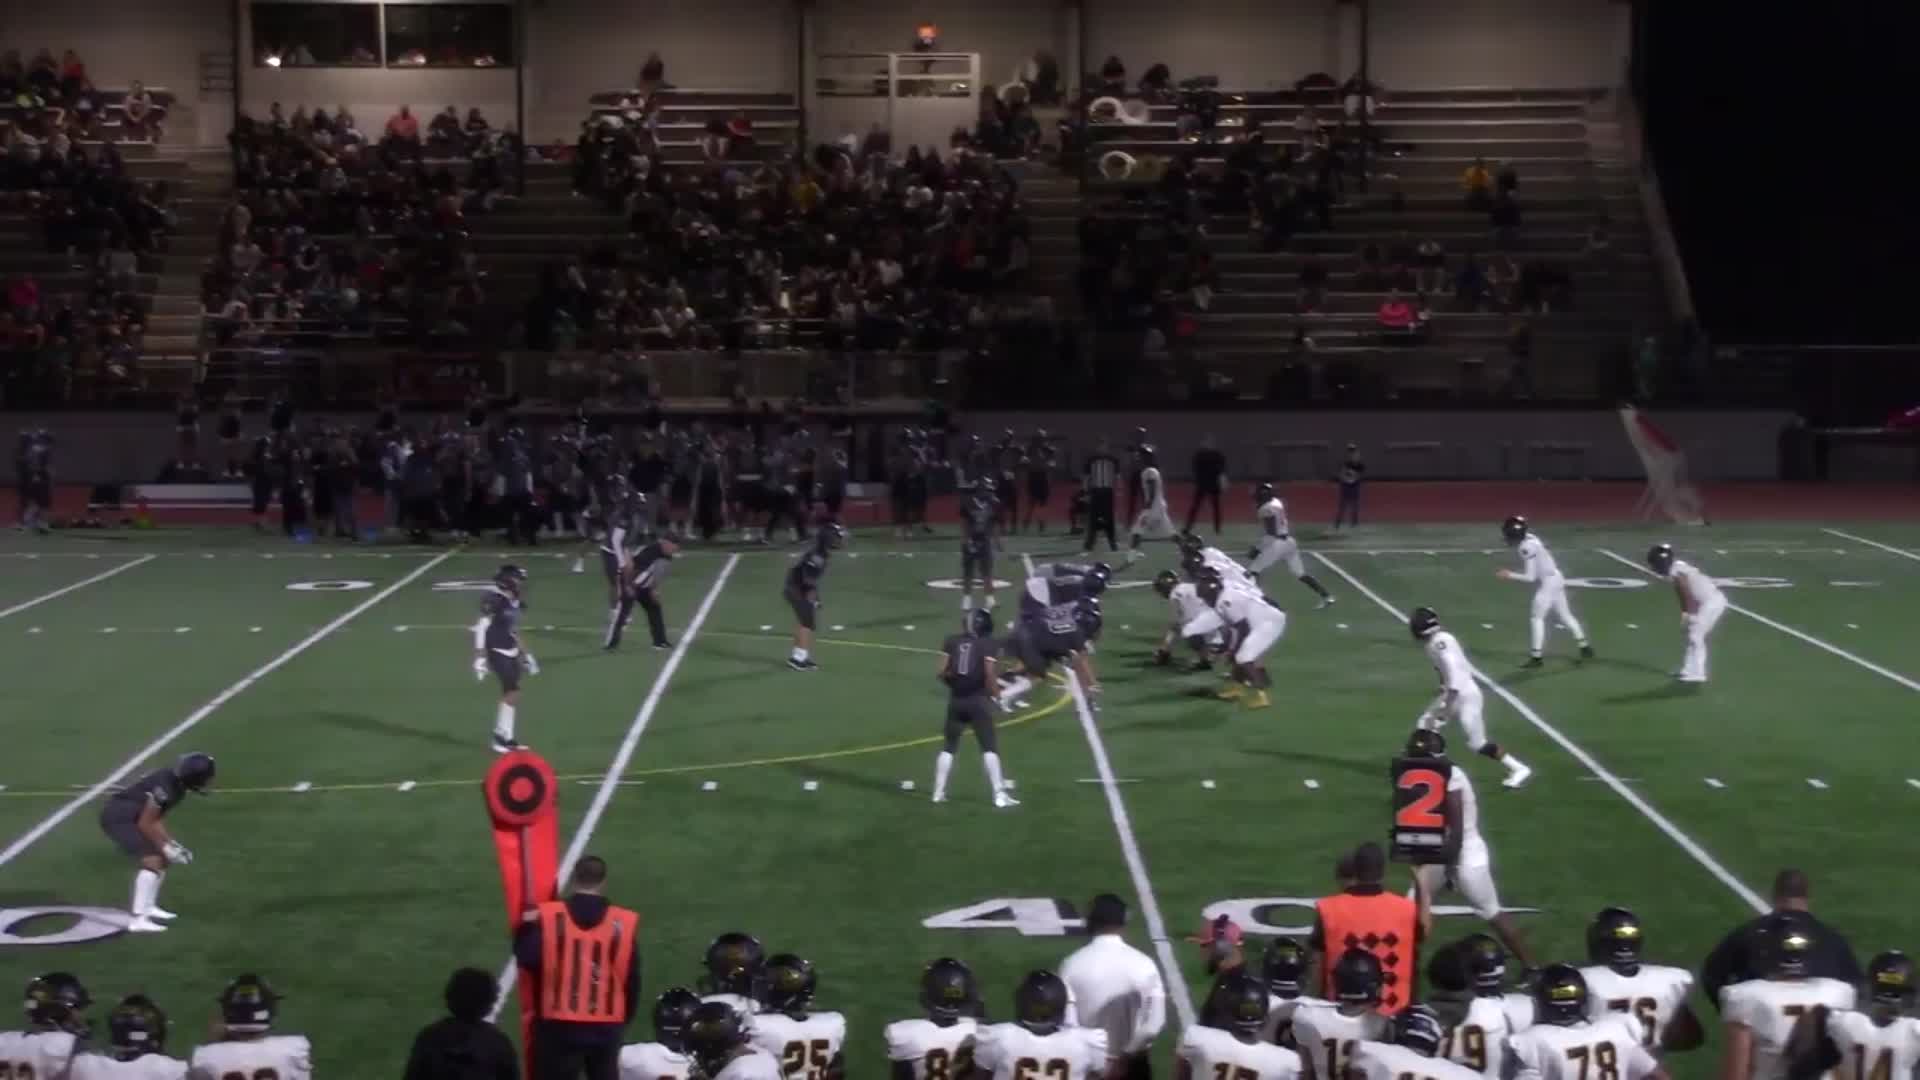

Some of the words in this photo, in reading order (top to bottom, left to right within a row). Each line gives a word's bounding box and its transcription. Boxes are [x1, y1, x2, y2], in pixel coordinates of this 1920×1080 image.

[1395, 768, 1446, 827] 2
[783, 1039, 831, 1080] 25
[1566, 1040, 1618, 1080] 78
